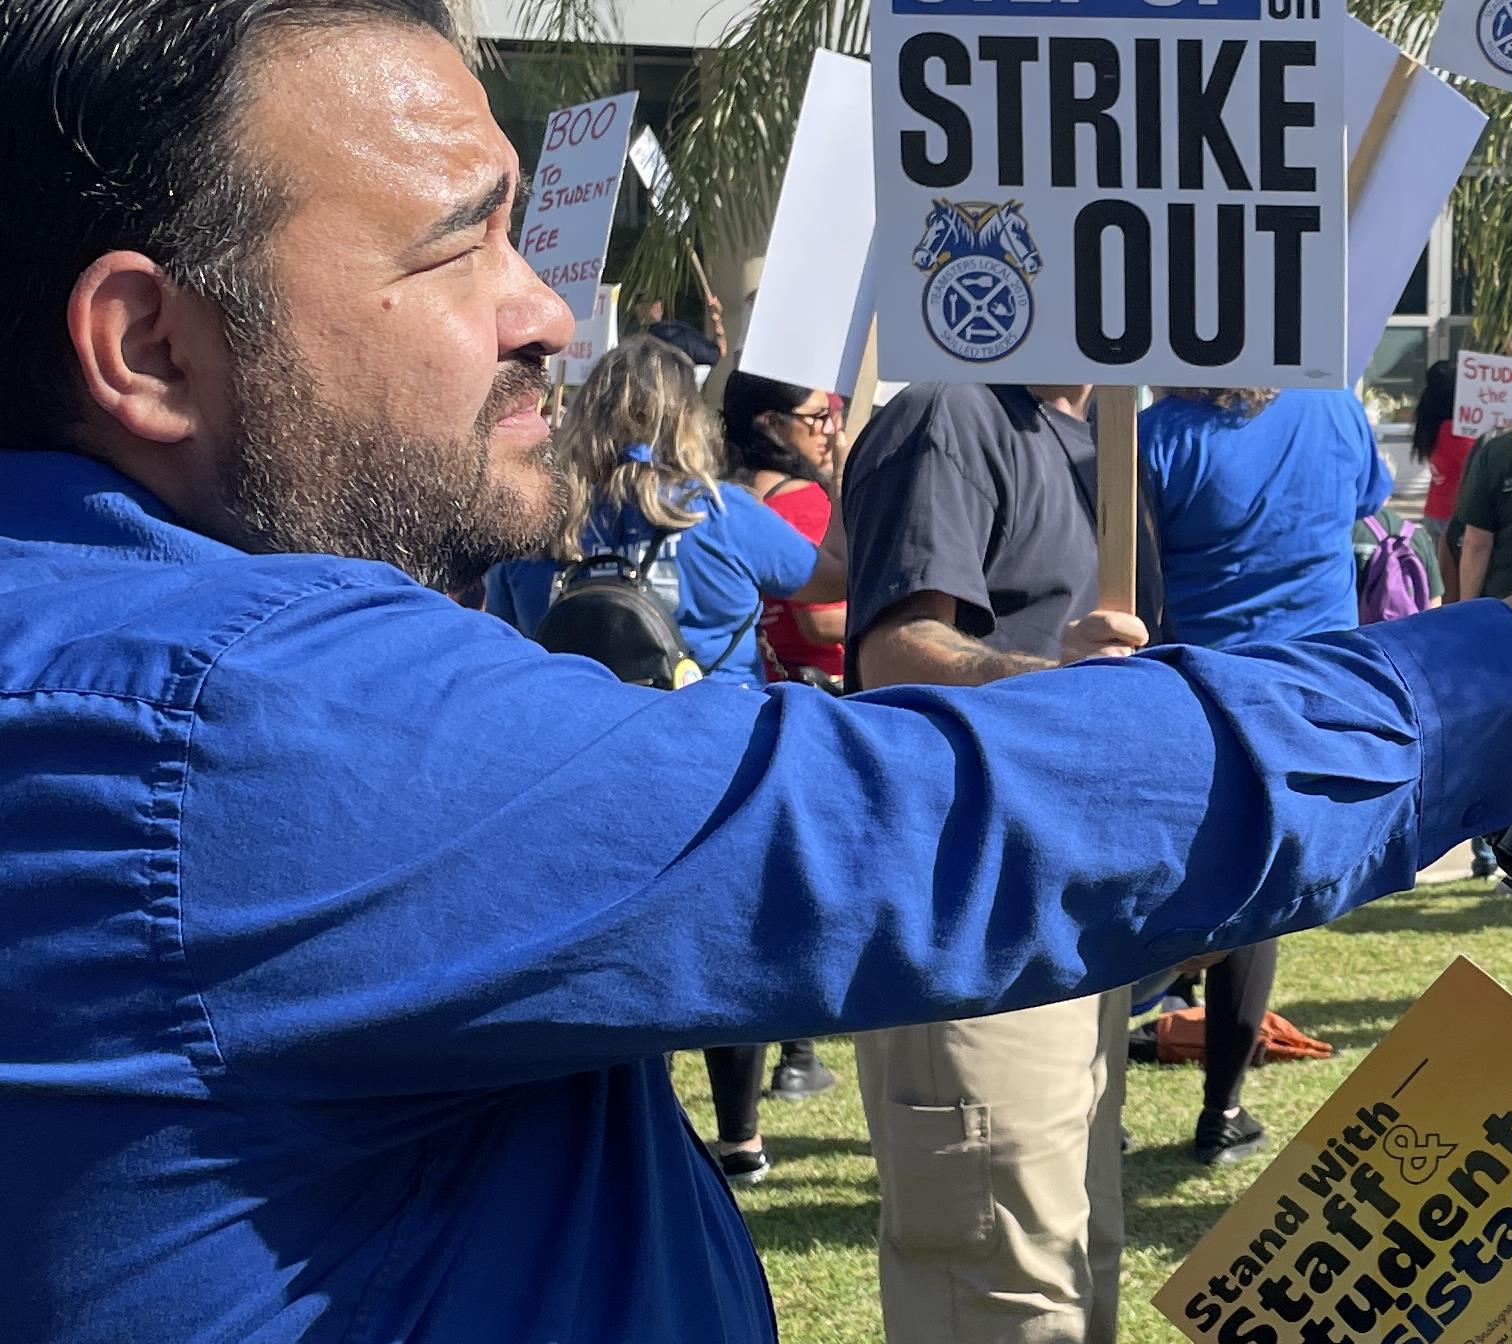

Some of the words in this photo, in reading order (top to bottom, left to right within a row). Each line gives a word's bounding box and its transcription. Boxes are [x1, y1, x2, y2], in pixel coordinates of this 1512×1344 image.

[546, 102, 617, 151] BOO
[899, 31, 1317, 192] STRIKE
[538, 176, 616, 212] STUDENT
[523, 223, 560, 257] FEE
[1074, 199, 1321, 366] OUT
[1459, 406, 1483, 424] NO
[1184, 1195, 1309, 1333] Stand
[1298, 1101, 1400, 1199] With
